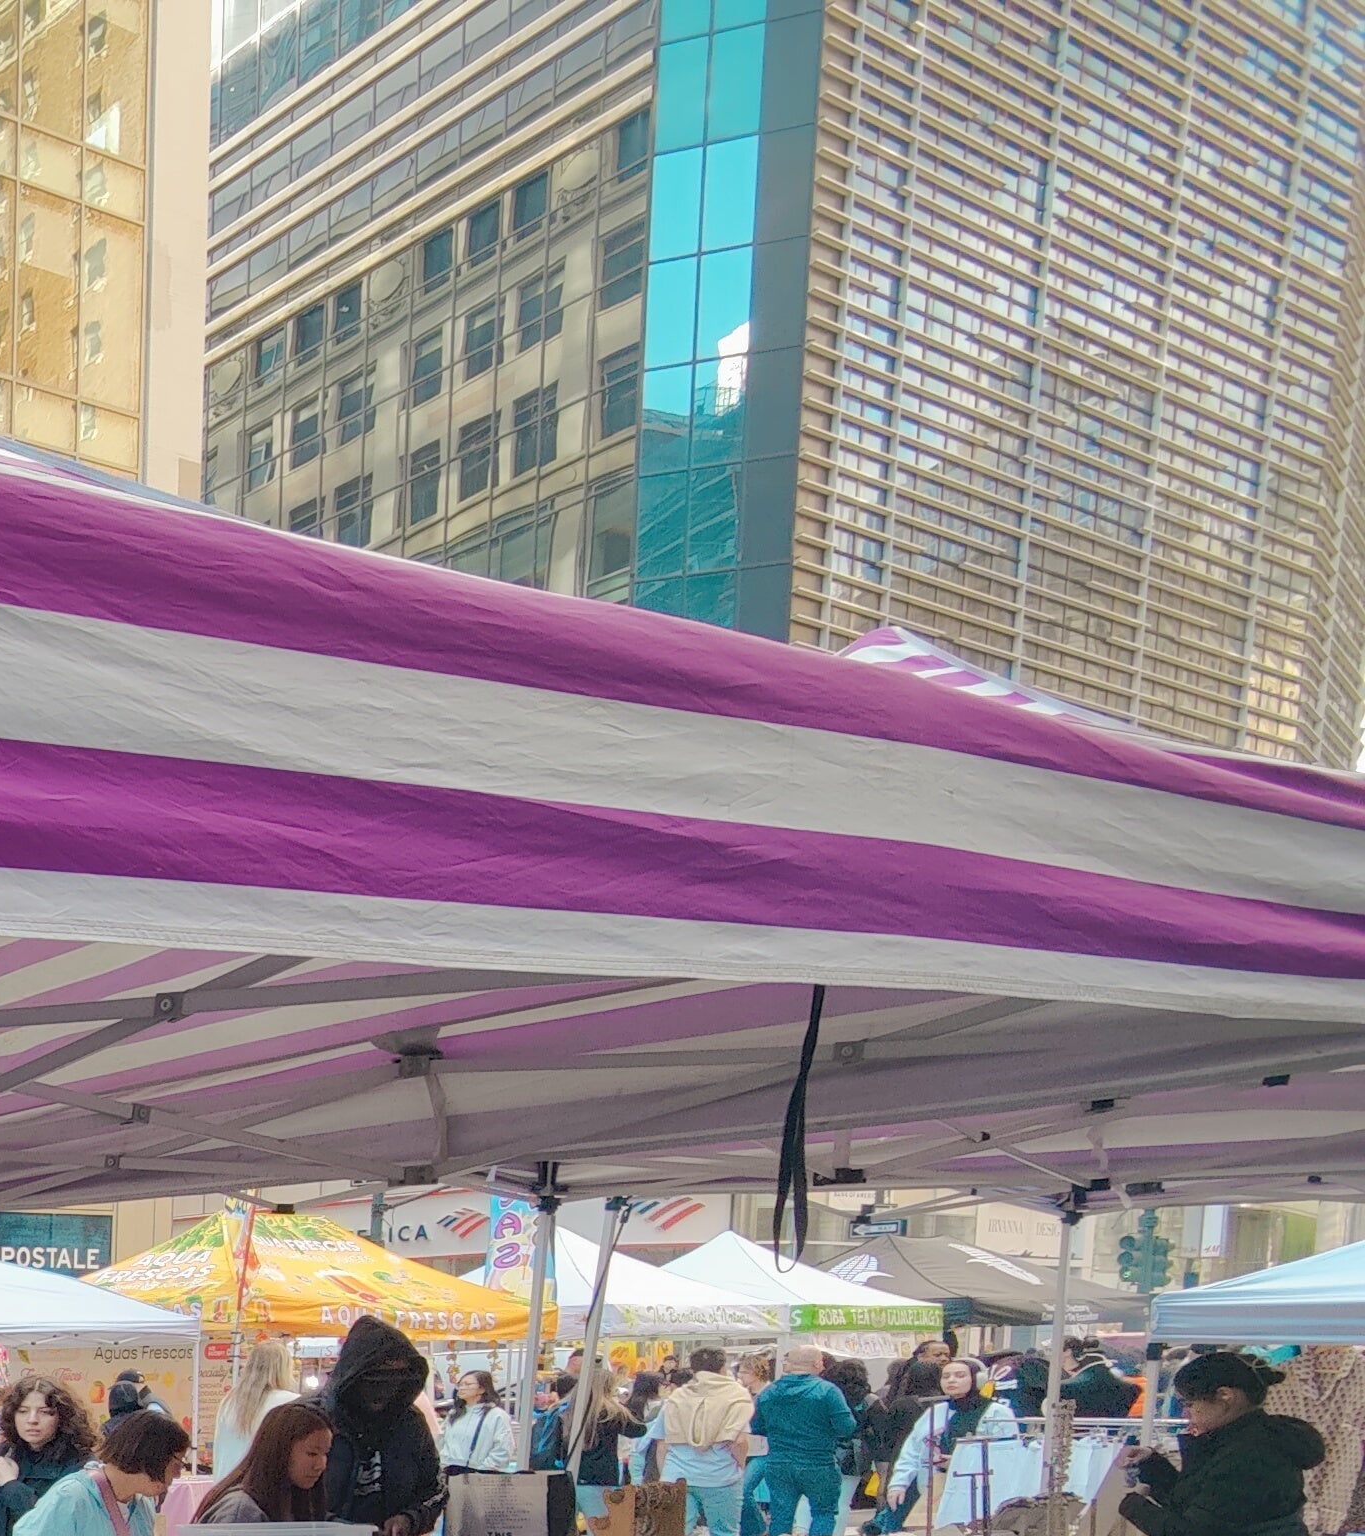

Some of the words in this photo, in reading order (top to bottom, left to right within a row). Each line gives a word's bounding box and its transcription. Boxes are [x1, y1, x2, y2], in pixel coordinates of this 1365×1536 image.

[130, 1250, 212, 1270] AQUA
[95, 1265, 216, 1285] FRESCAS
[395, 1310, 497, 1331] FRESCAS
[819, 1309, 846, 1326] BOBA
[850, 1309, 869, 1325] TEA
[93, 1346, 138, 1364] Aguas
[141, 1346, 194, 1360] Frescas
